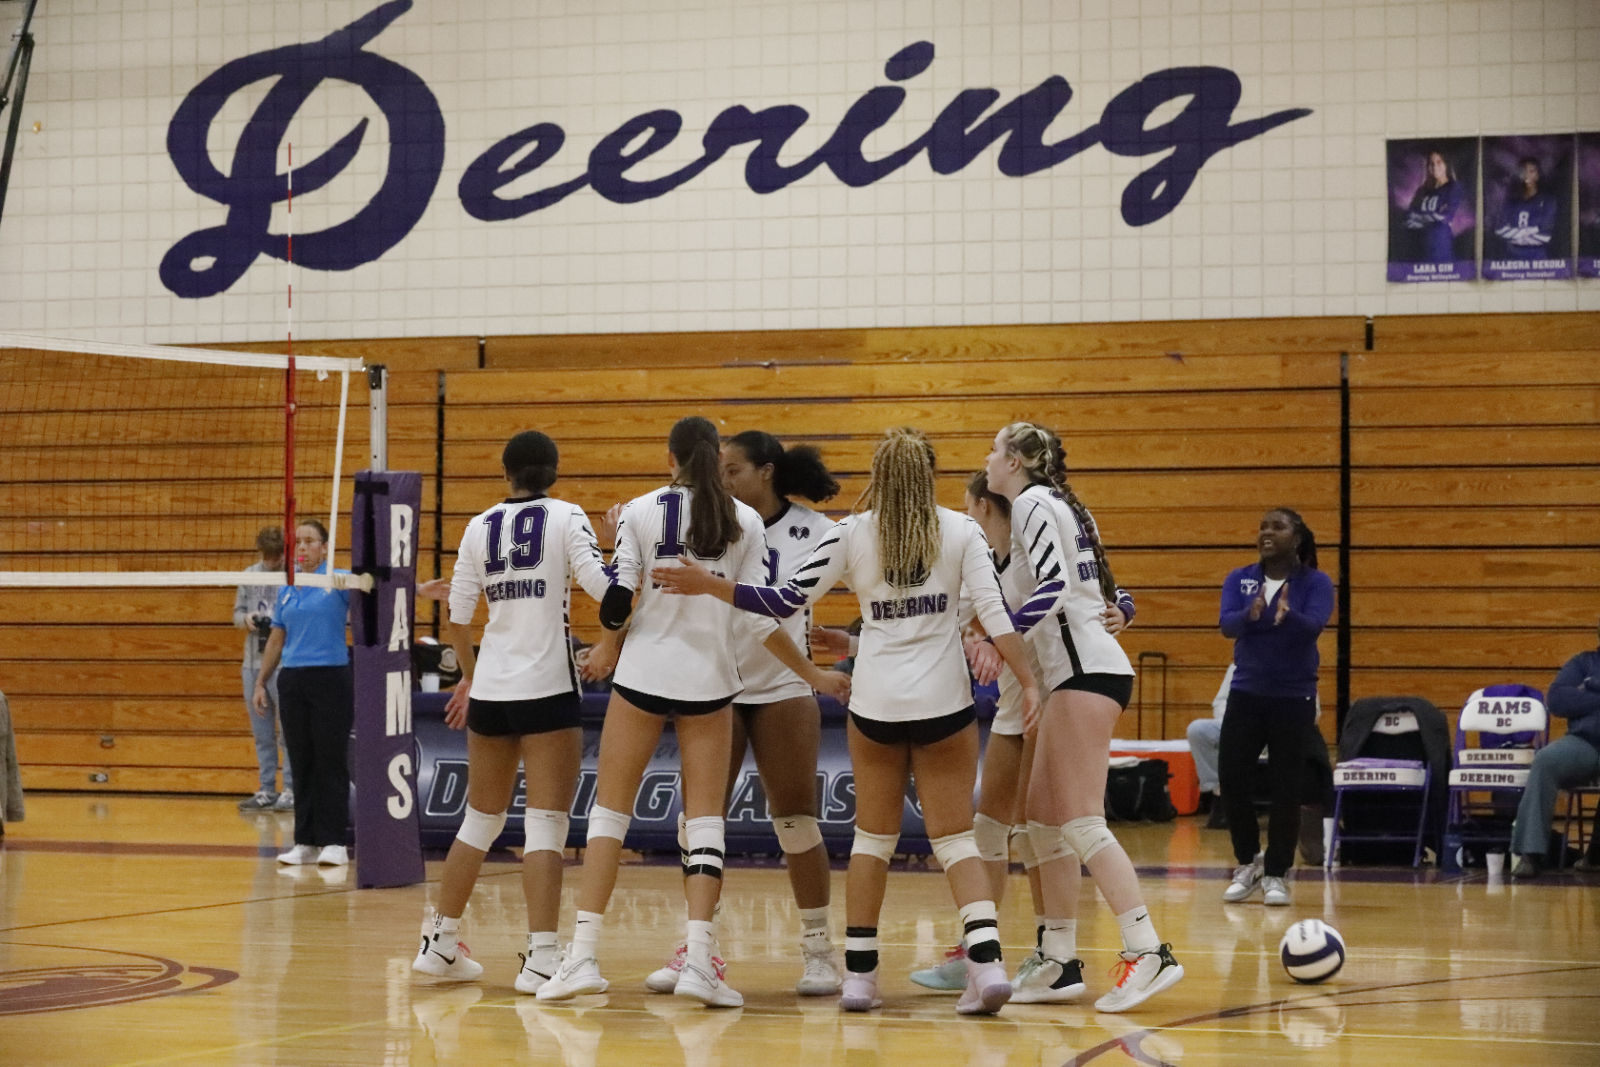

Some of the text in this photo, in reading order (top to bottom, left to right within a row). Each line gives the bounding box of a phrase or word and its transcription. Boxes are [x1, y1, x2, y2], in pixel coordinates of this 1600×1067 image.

[159, 0, 1312, 298] Deering
[1413, 263, 1437, 273] LARA
[483, 504, 549, 577] 19
[870, 593, 949, 621] DEERING
[386, 503, 414, 819] RAMS
[1478, 701, 1532, 714] RAMS
[1384, 716, 1400, 727] BC
[1496, 717, 1512, 727] BC
[1466, 753, 1514, 762] DEERING
[1342, 772, 1397, 782] DEERING
[1460, 772, 1515, 783] DEERING
